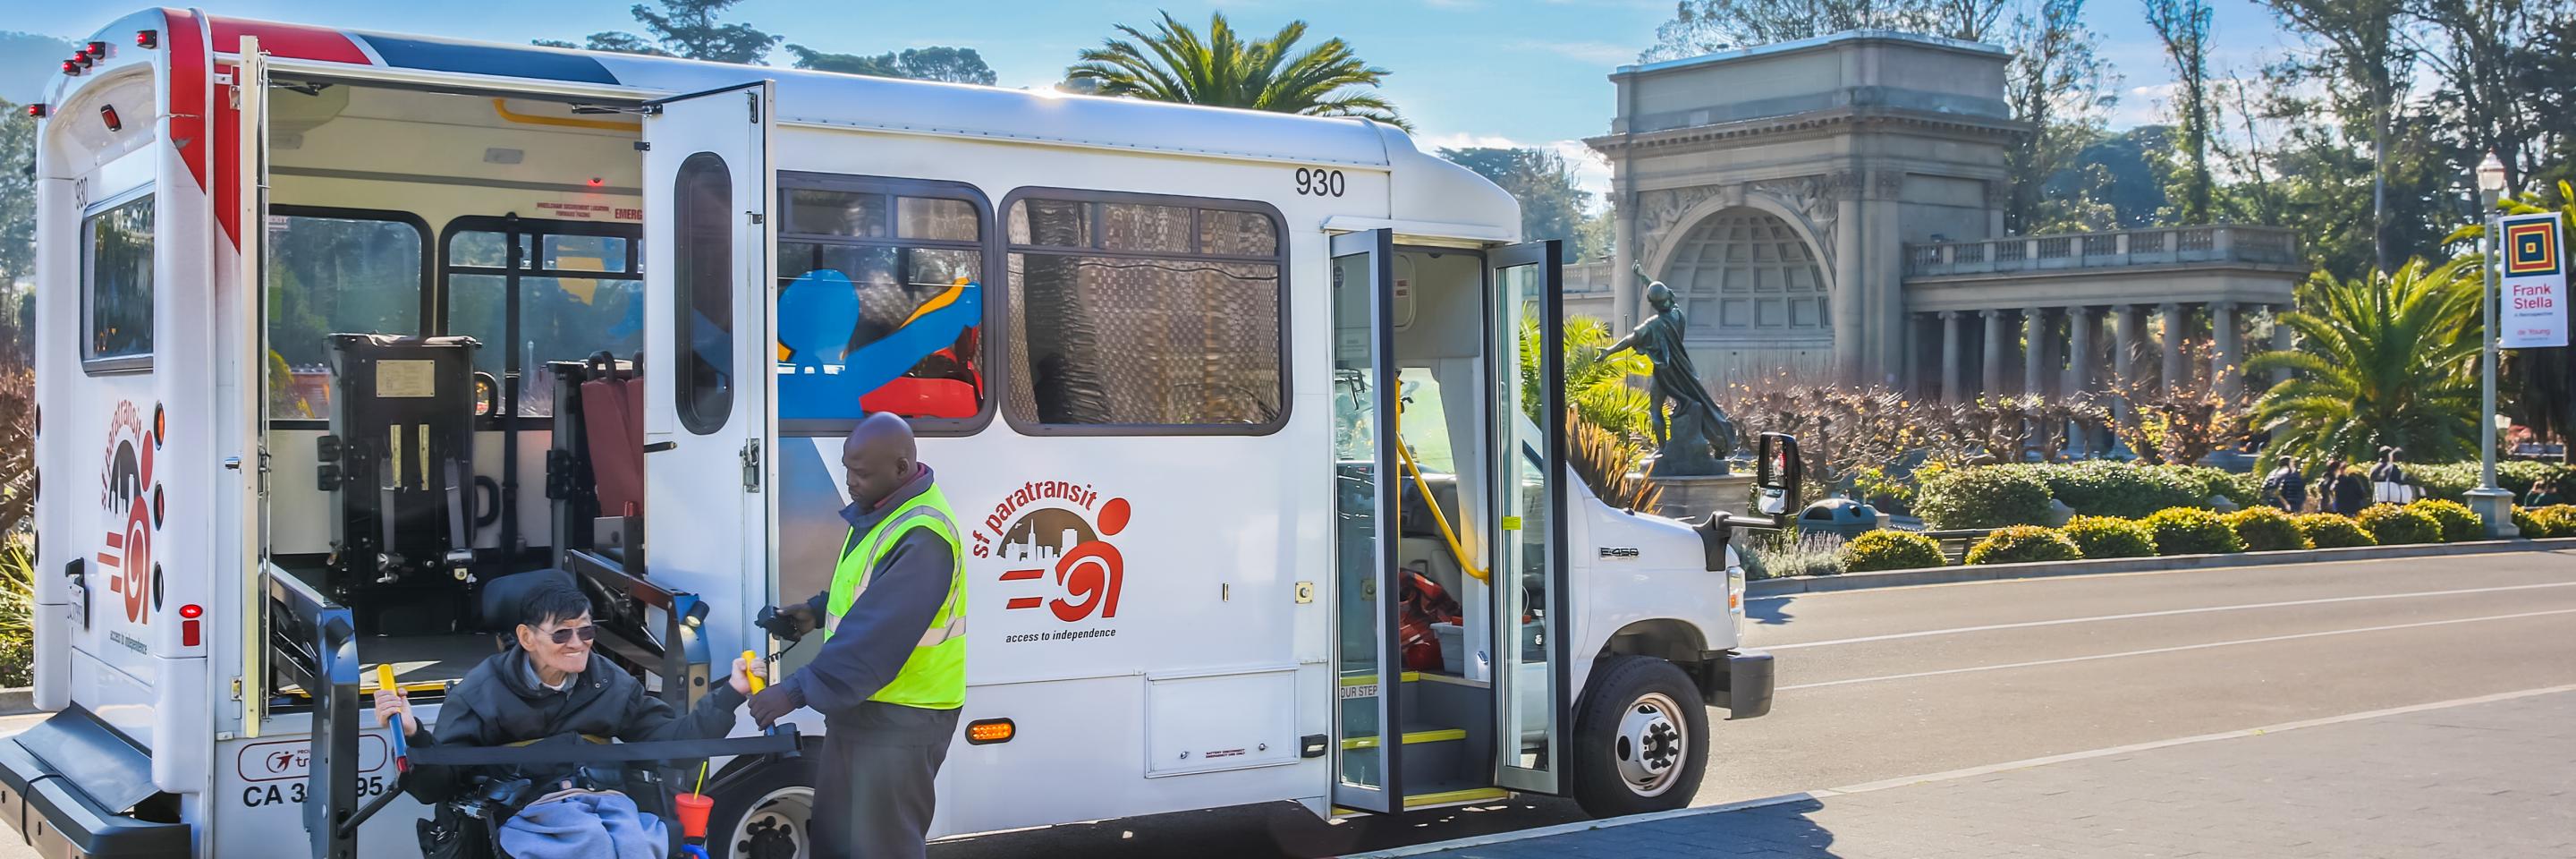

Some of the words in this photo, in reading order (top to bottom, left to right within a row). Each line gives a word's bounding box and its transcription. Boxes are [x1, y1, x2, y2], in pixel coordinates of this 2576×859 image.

[76, 176, 89, 210] 930
[1295, 167, 1345, 198] 930
[2513, 284, 2552, 296] Frank
[2513, 297, 2553, 310] Stella
[106, 399, 142, 478] paratransit
[973, 530, 990, 558] sf
[986, 481, 1097, 537] paratransit
[1005, 634, 1038, 643] access
[1041, 631, 1050, 641] to
[1053, 628, 1116, 642] independence
[1359, 685, 1377, 696] STEP
[243, 784, 284, 808] CA
